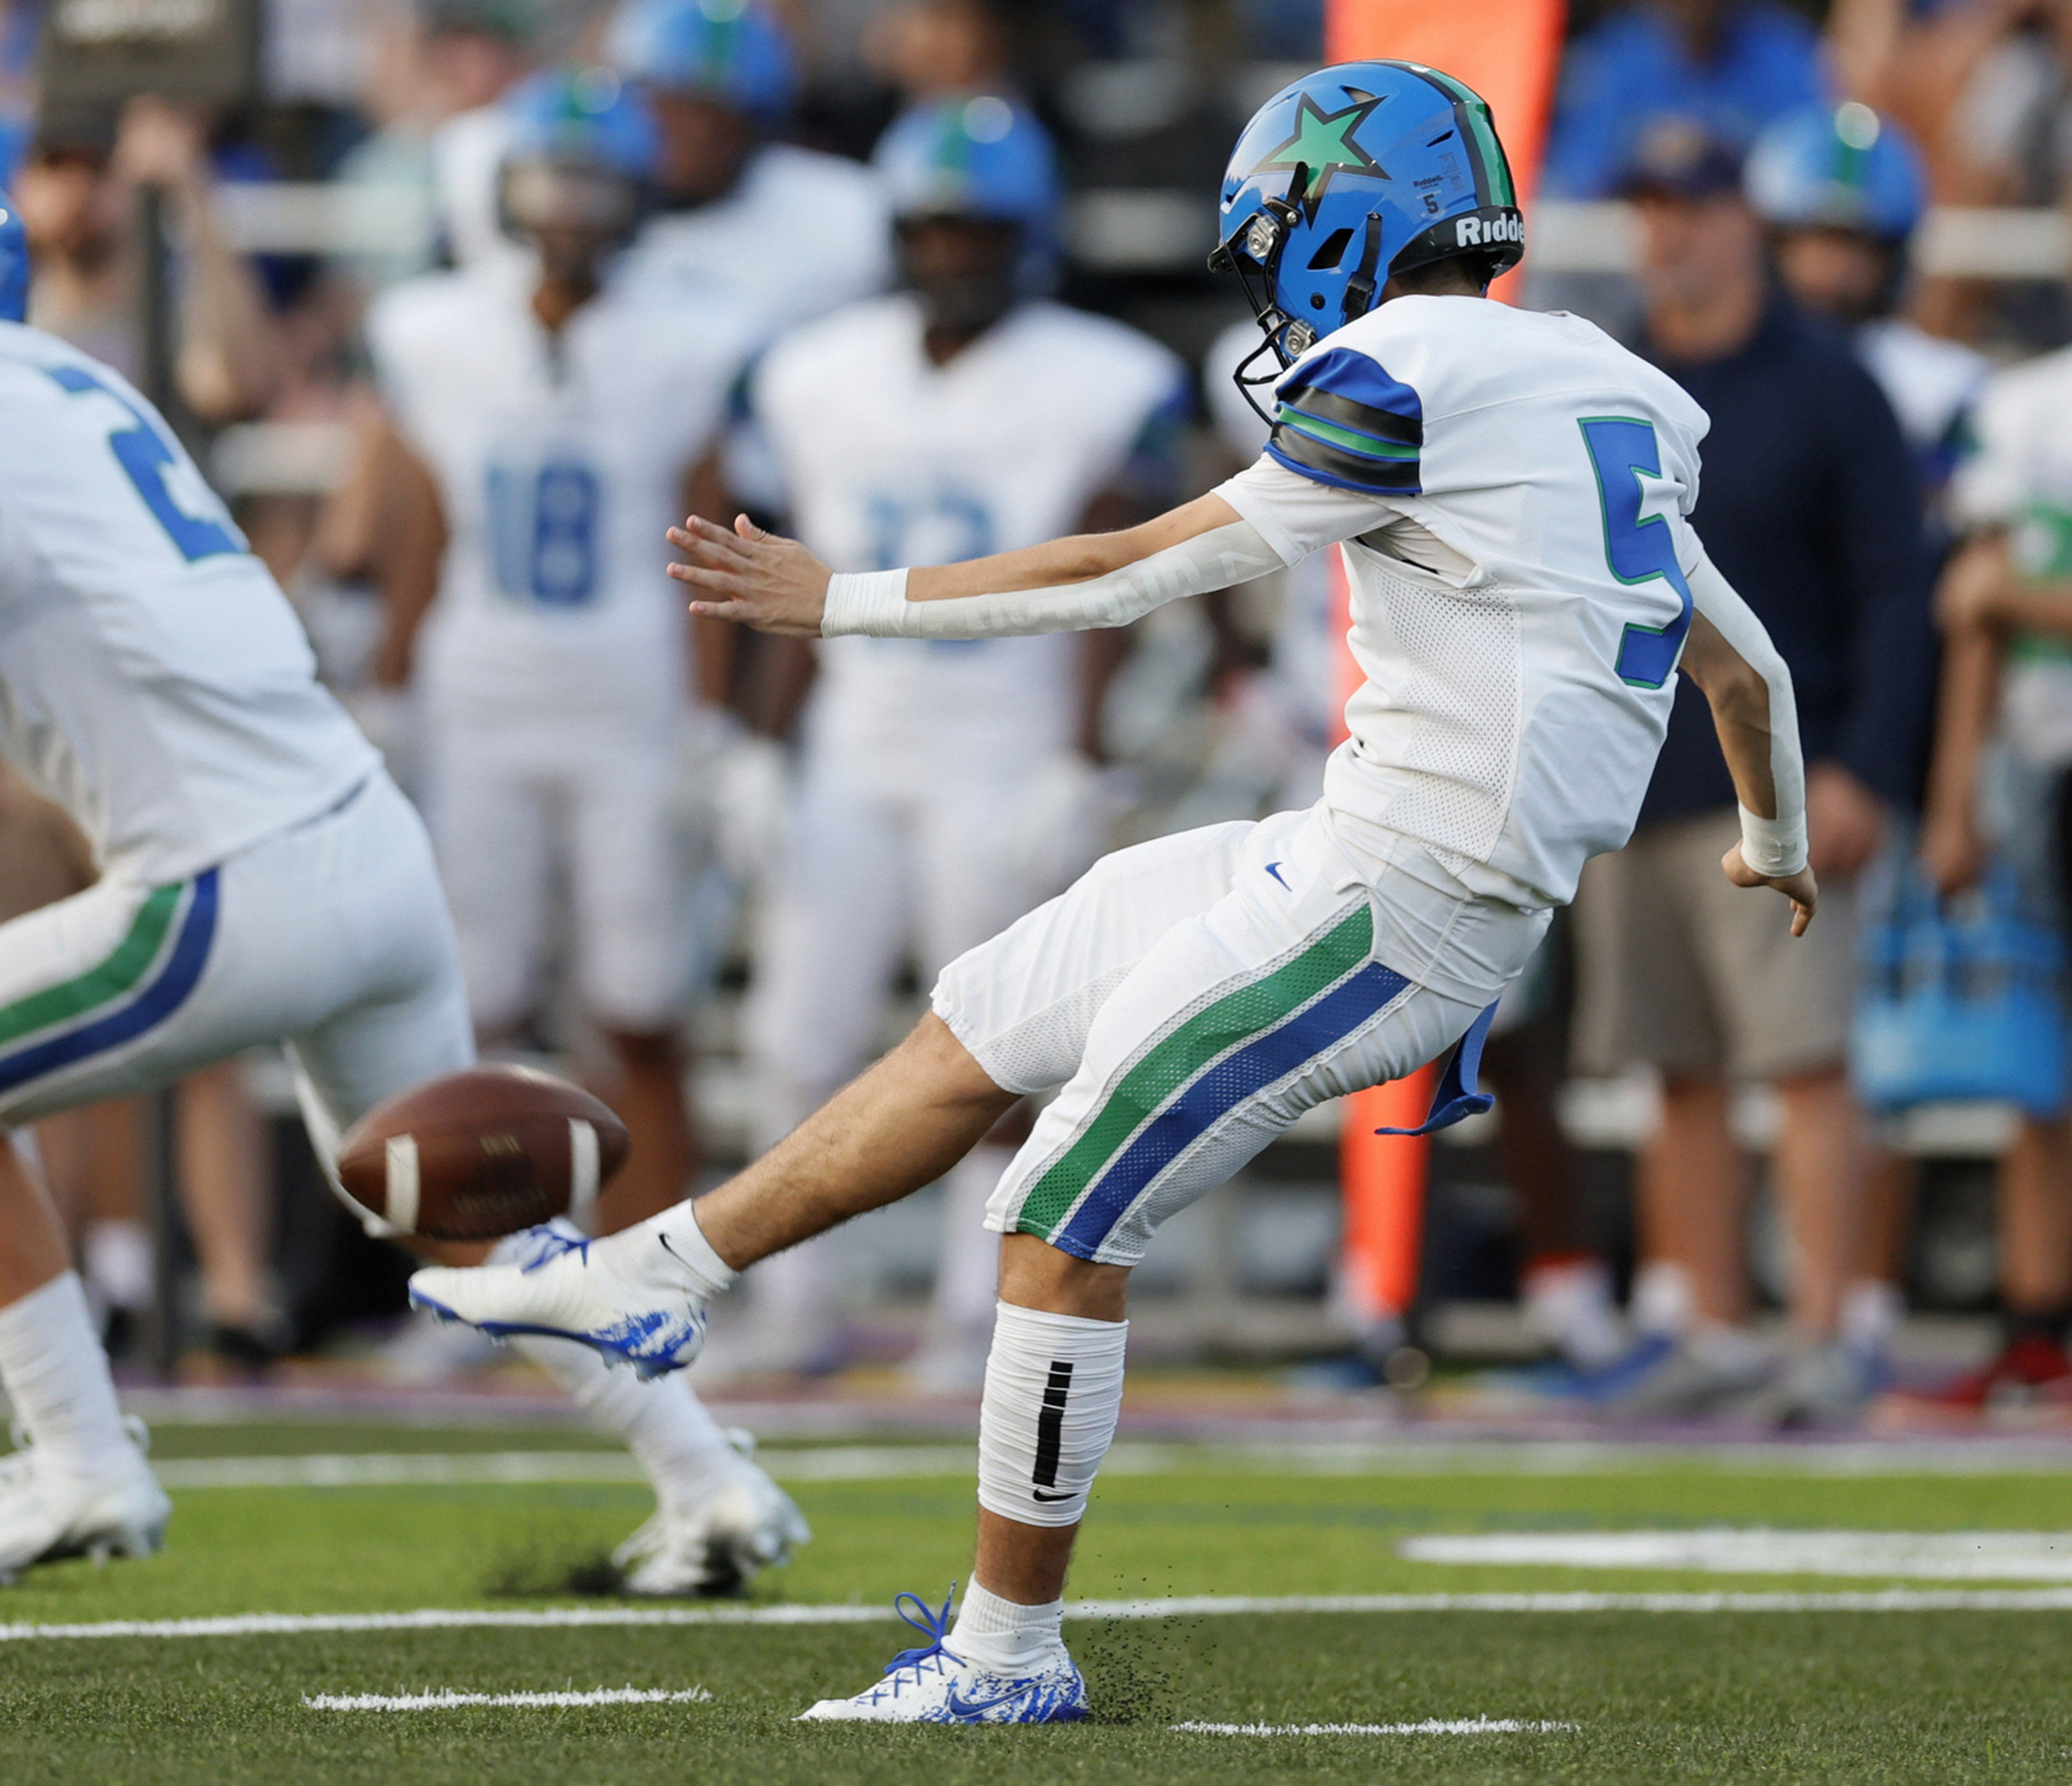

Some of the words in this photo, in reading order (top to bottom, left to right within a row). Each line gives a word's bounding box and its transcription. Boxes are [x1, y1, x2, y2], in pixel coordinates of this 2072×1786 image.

[1423, 193, 1439, 214] 5
[483, 459, 602, 609] 18
[1577, 415, 1694, 690] 5
